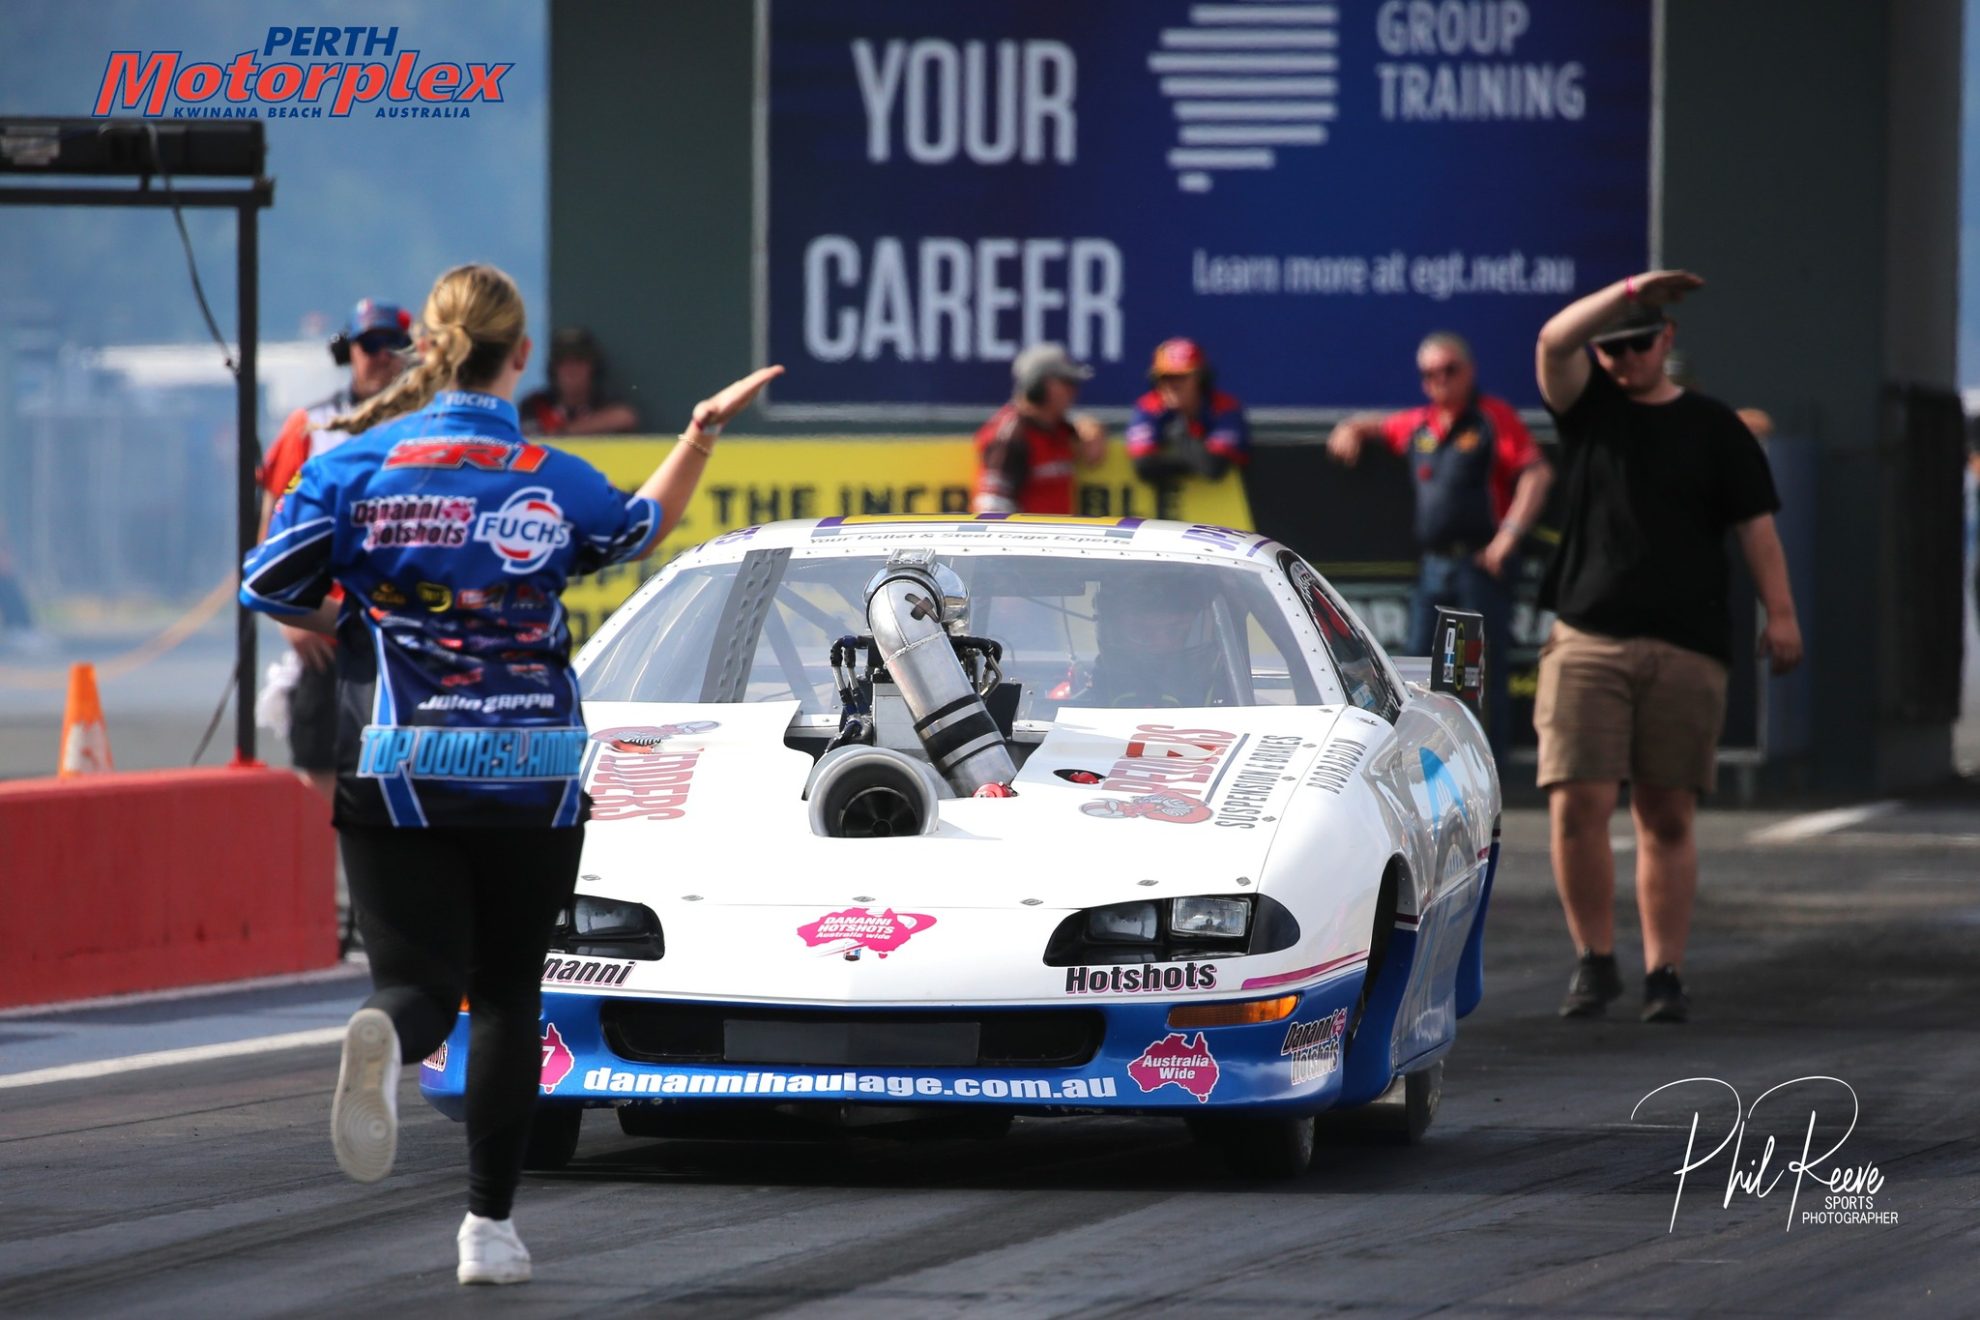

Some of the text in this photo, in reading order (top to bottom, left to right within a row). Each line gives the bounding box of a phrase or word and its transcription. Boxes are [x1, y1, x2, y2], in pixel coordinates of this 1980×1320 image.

[1376, 0, 1530, 55] GROUP
[852, 39, 1077, 163] YOUR
[1377, 63, 1585, 121] TRAINING
[1192, 248, 1279, 294] Learn
[1284, 254, 1368, 294] more
[1371, 251, 1406, 293] at
[804, 235, 1124, 364] CAREER
[445, 391, 498, 410] FUCHS
[707, 484, 816, 528] THE
[481, 516, 571, 545] FUCHS
[359, 730, 415, 774] TOP
[590, 751, 701, 820] EDDERS
[1214, 769, 1281, 829] SUSPENSION
[1249, 734, 1304, 763] BRAKES
[817, 924, 895, 934] HOTSHOTS
[824, 916, 893, 926] DANANNI
[541, 957, 636, 987] nanni
[1066, 962, 1217, 994] Hotshots
[1281, 1010, 1338, 1056] Dananni
[584, 1067, 1117, 1099] danannihaulage.com.au
[1142, 1055, 1209, 1068] Australia
[1160, 1067, 1195, 1080] Wide
